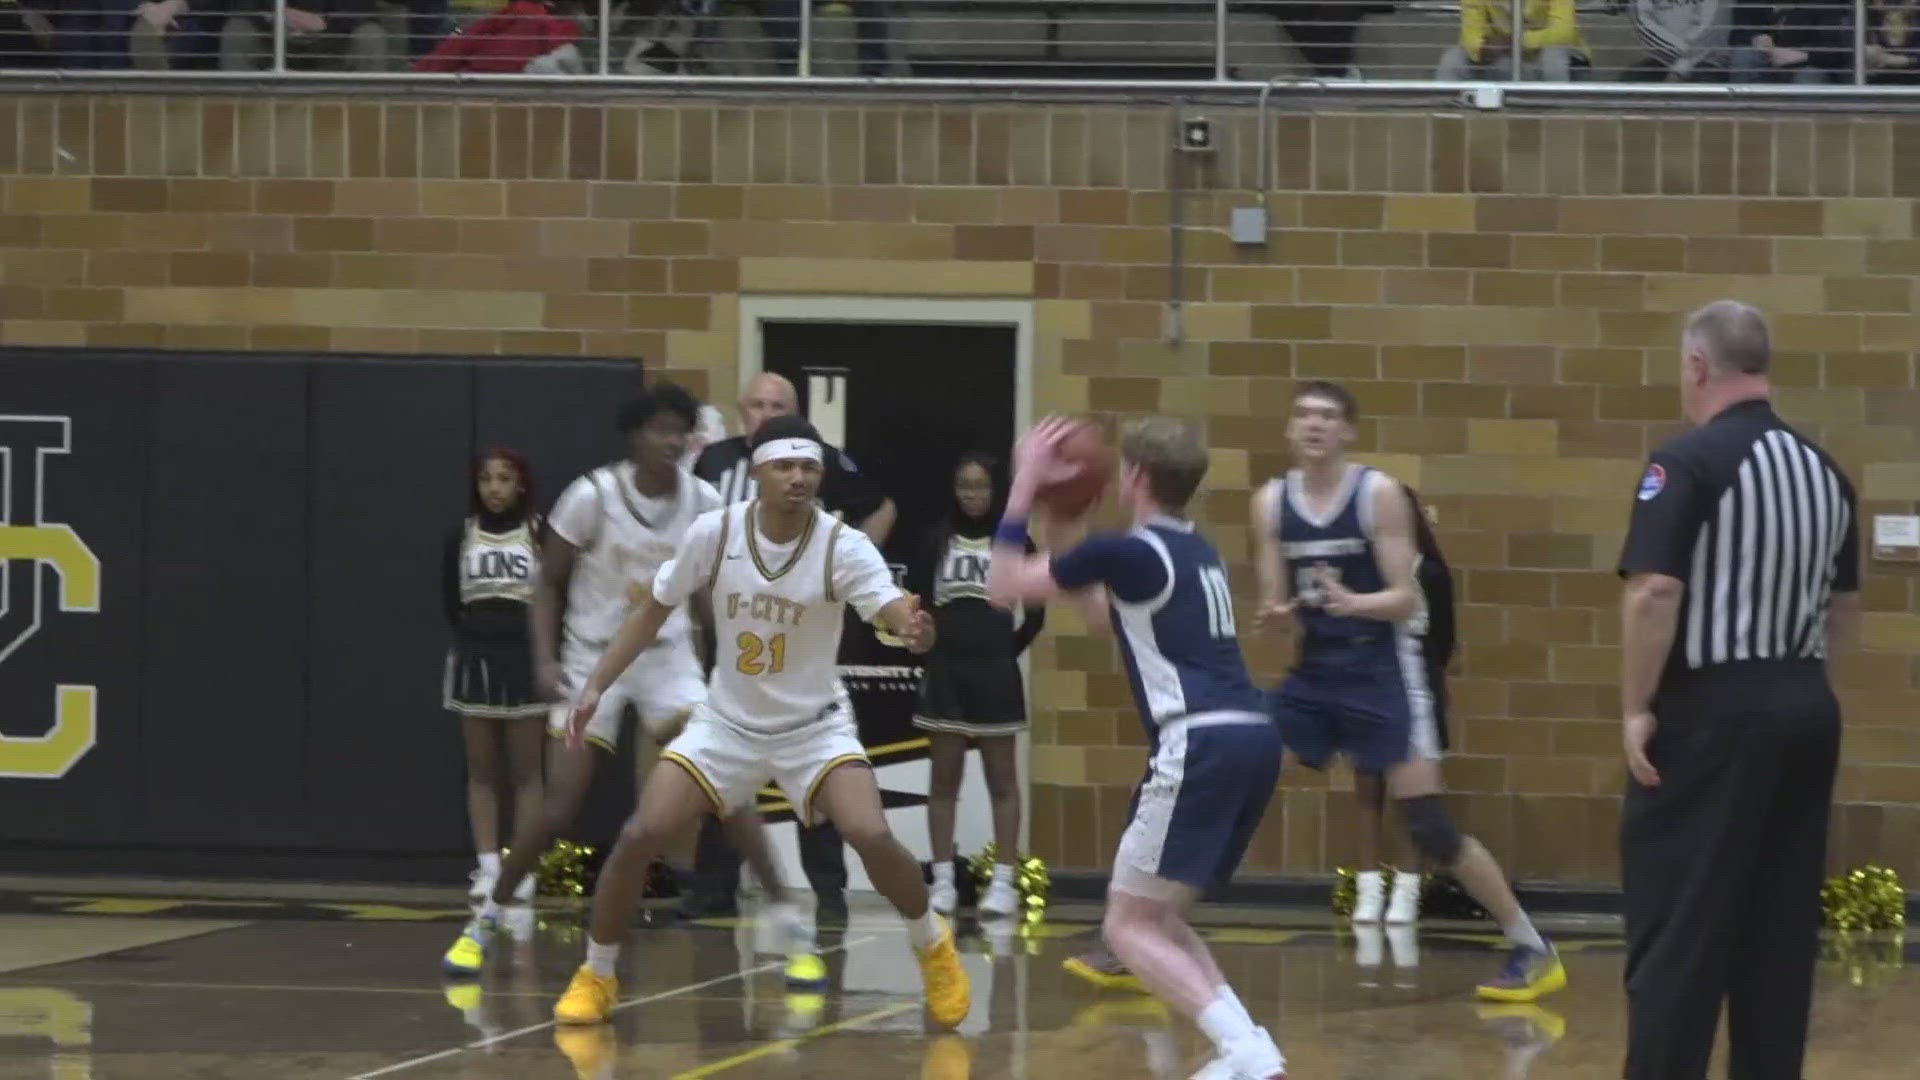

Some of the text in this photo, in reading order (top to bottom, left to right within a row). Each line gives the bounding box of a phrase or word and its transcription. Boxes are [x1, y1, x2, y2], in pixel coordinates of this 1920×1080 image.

[467, 551, 529, 579] LIONS
[941, 555, 995, 584] LION
[727, 592, 806, 626] U-CITY
[1198, 564, 1237, 638] 10
[735, 631, 786, 675] 21
